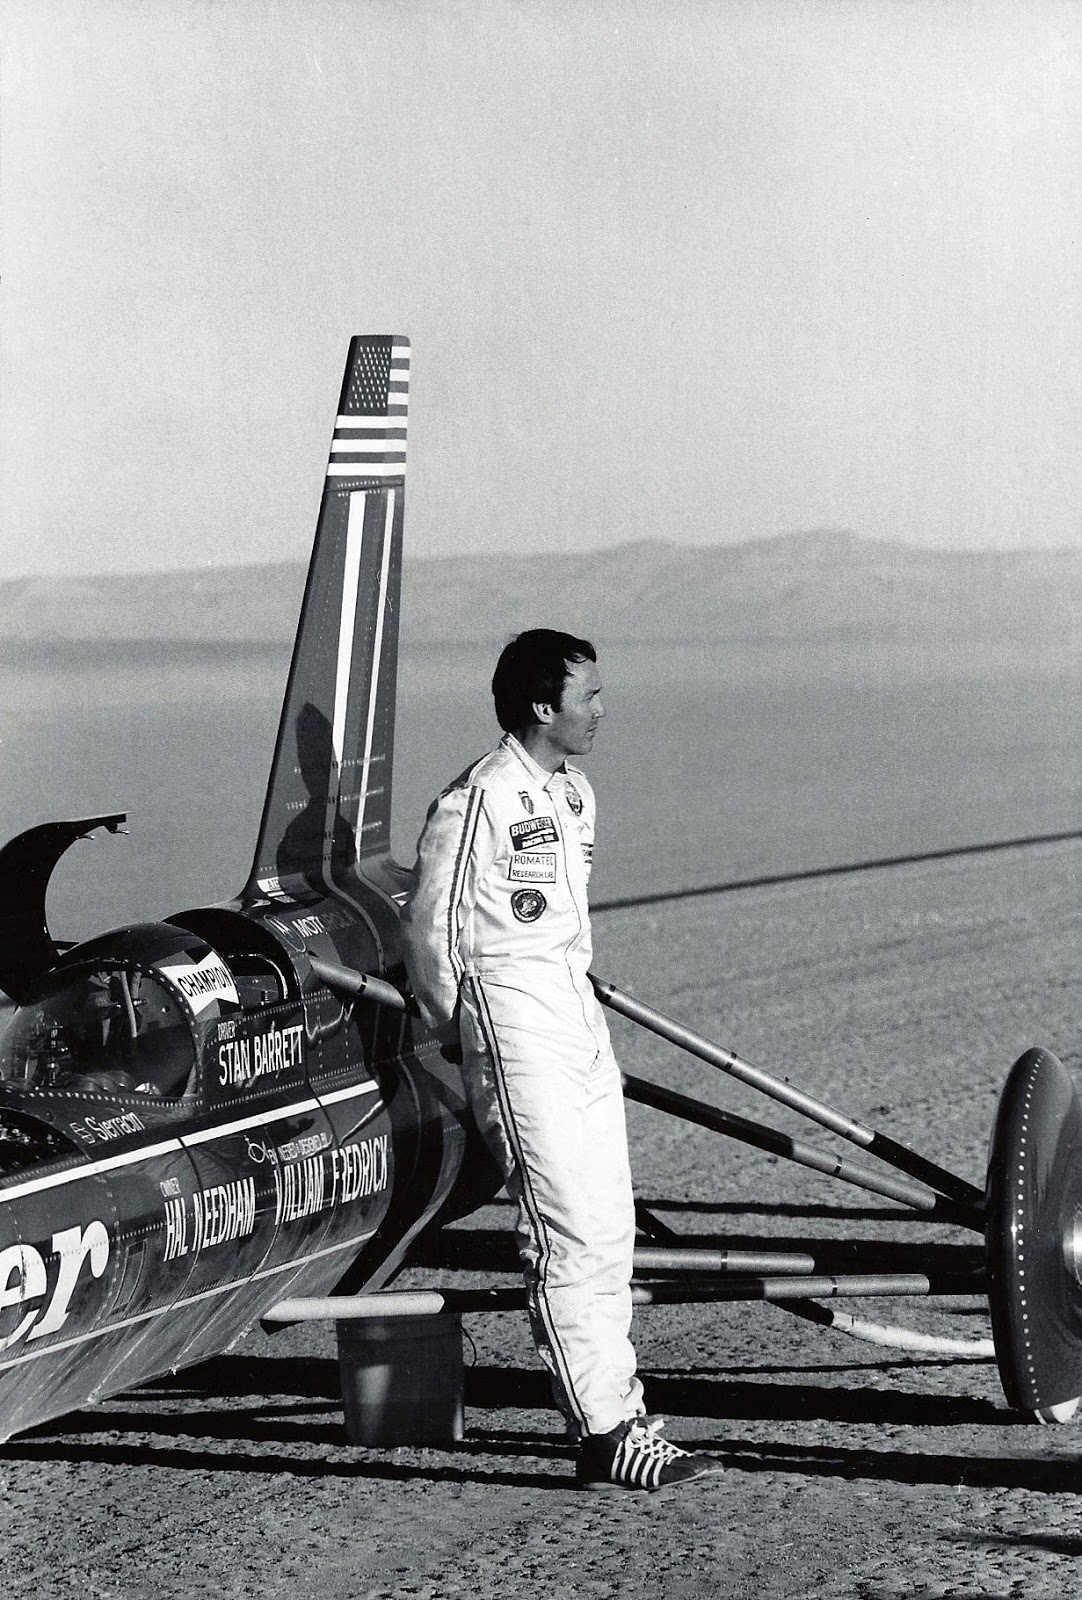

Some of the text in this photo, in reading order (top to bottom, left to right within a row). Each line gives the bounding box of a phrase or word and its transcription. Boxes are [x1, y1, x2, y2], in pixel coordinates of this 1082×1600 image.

[512, 869, 543, 879] RESEARCH
[177, 965, 233, 998] CHAMPION
[219, 1024, 304, 1086] STAN BARRETT
[330, 1134, 388, 1207] FREDRICK
[163, 1176, 256, 1262] HAL NEEDHAM
